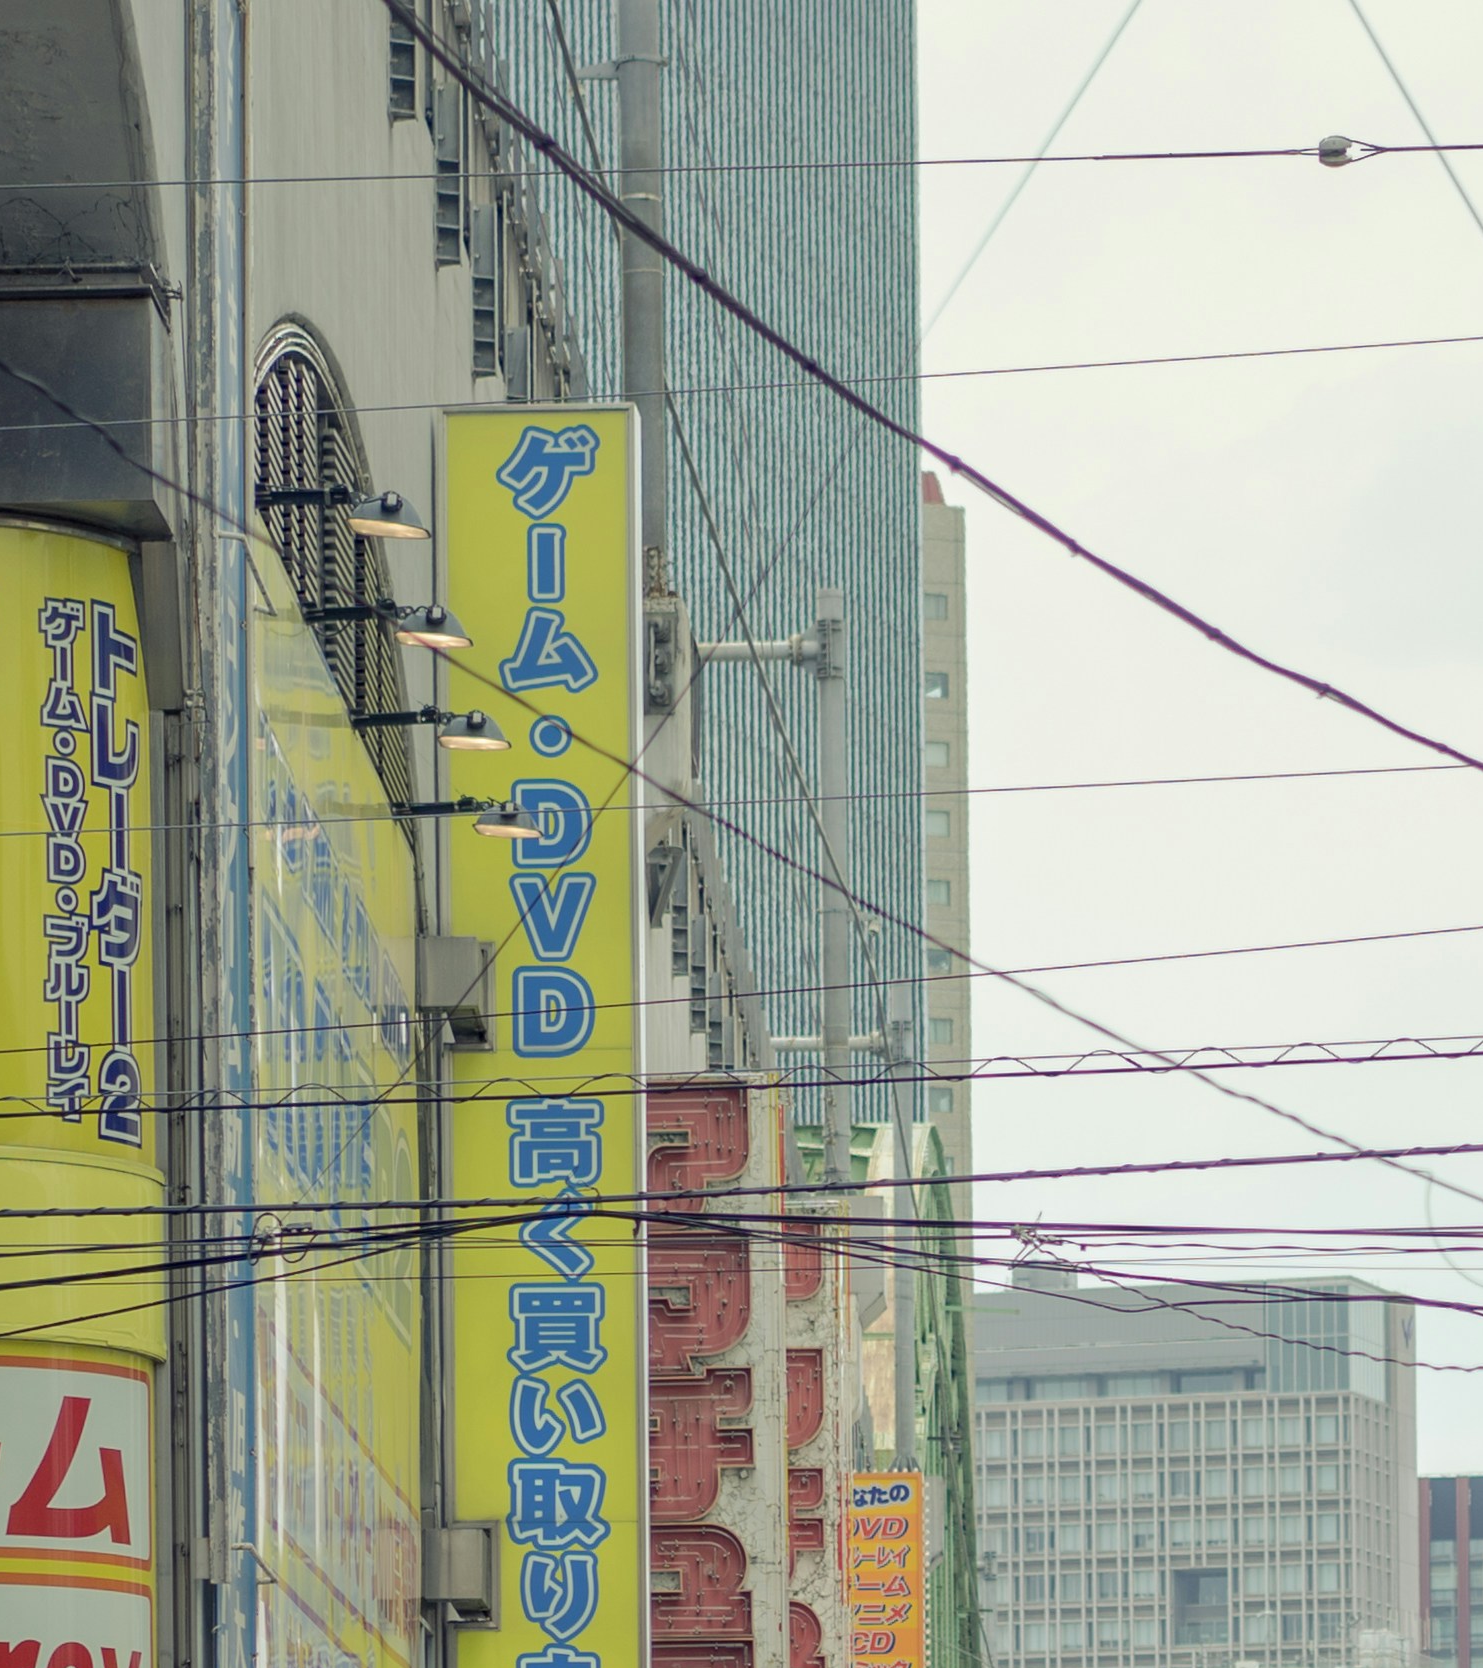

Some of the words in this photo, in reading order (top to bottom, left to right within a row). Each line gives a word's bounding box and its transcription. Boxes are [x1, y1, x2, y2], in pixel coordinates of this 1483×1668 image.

[90, 597, 145, 1150] トレーダー2
[854, 1518, 909, 1540] VD
